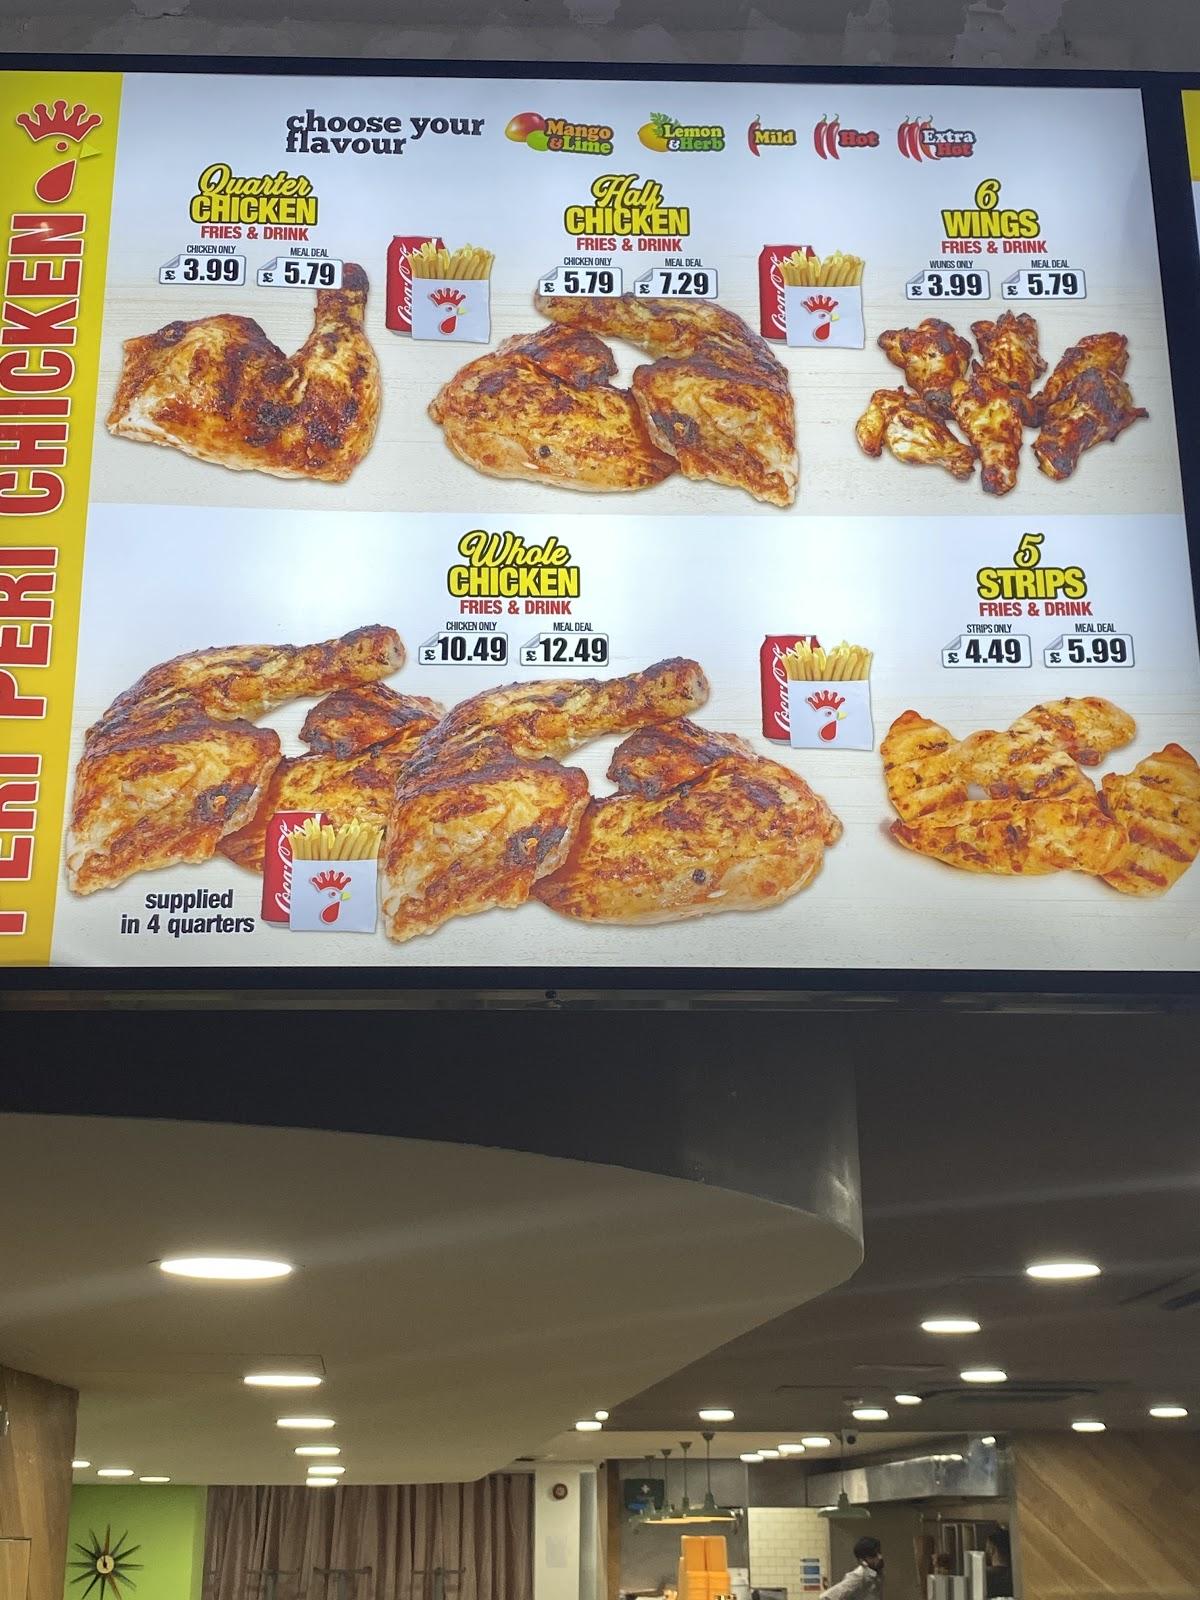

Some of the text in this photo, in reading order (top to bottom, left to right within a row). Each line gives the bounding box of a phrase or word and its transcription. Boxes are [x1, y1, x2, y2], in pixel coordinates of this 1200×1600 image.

[286, 110, 485, 139] choose your
[546, 119, 613, 140] Mango
[663, 123, 724, 138] Lemon
[286, 130, 407, 155] flavour
[753, 129, 796, 146] Mild
[838, 130, 880, 147] Hot
[922, 130, 976, 145] Extra
[935, 143, 974, 157] Hot
[199, 163, 313, 196] Quarter
[591, 174, 663, 212] Half
[975, 178, 1001, 210] 6
[190, 195, 318, 225] CHICKEN
[565, 206, 690, 235] CHICKEN
[201, 226, 309, 241] FRIES & DRINK
[941, 209, 1040, 239] WINGS
[186, 244, 236, 254] CHICKEN ONLY
[290, 247, 329, 257] MEAL DEAL
[577, 238, 682, 252] FRIES & DRINK
[942, 240, 1048, 254] FRIES & DRINK
[183, 258, 240, 281] 3.99
[564, 257, 612, 266] CHICKEN ONLY
[665, 258, 703, 267] MEAL DEAL
[930, 260, 973, 269] WUNGS ONLY
[1031, 259, 1069, 268] MEAL DEAL
[284, 261, 336, 286] 5.79
[564, 271, 614, 294] 5.79
[660, 272, 709, 295] 7.29
[928, 273, 983, 296] 3.99
[1028, 273, 1077, 296] 5.79
[0, 213, 86, 516] CHICKEN
[458, 530, 571, 567] Whole
[1013, 533, 1045, 568] 5
[447, 564, 580, 598] CHICKEN
[977, 566, 1087, 600] STRIPS
[460, 600, 572, 614] FRIES & DRINK
[979, 602, 1093, 616] FRIES & DRINK
[446, 622, 497, 631] CHICKEN ONLY
[553, 622, 593, 631] MEAL DEAL
[967, 624, 1012, 633] STRIPS ONLY
[1075, 623, 1116, 633] MEAL DEAL
[438, 636, 507, 661] 10.49
[540, 637, 607, 662] 12.49
[966, 638, 1022, 664] 4.49
[1068, 638, 1127, 664] 5.99
[145, 889, 233, 914] supplied
[121, 914, 255, 938] in 4 quarters
